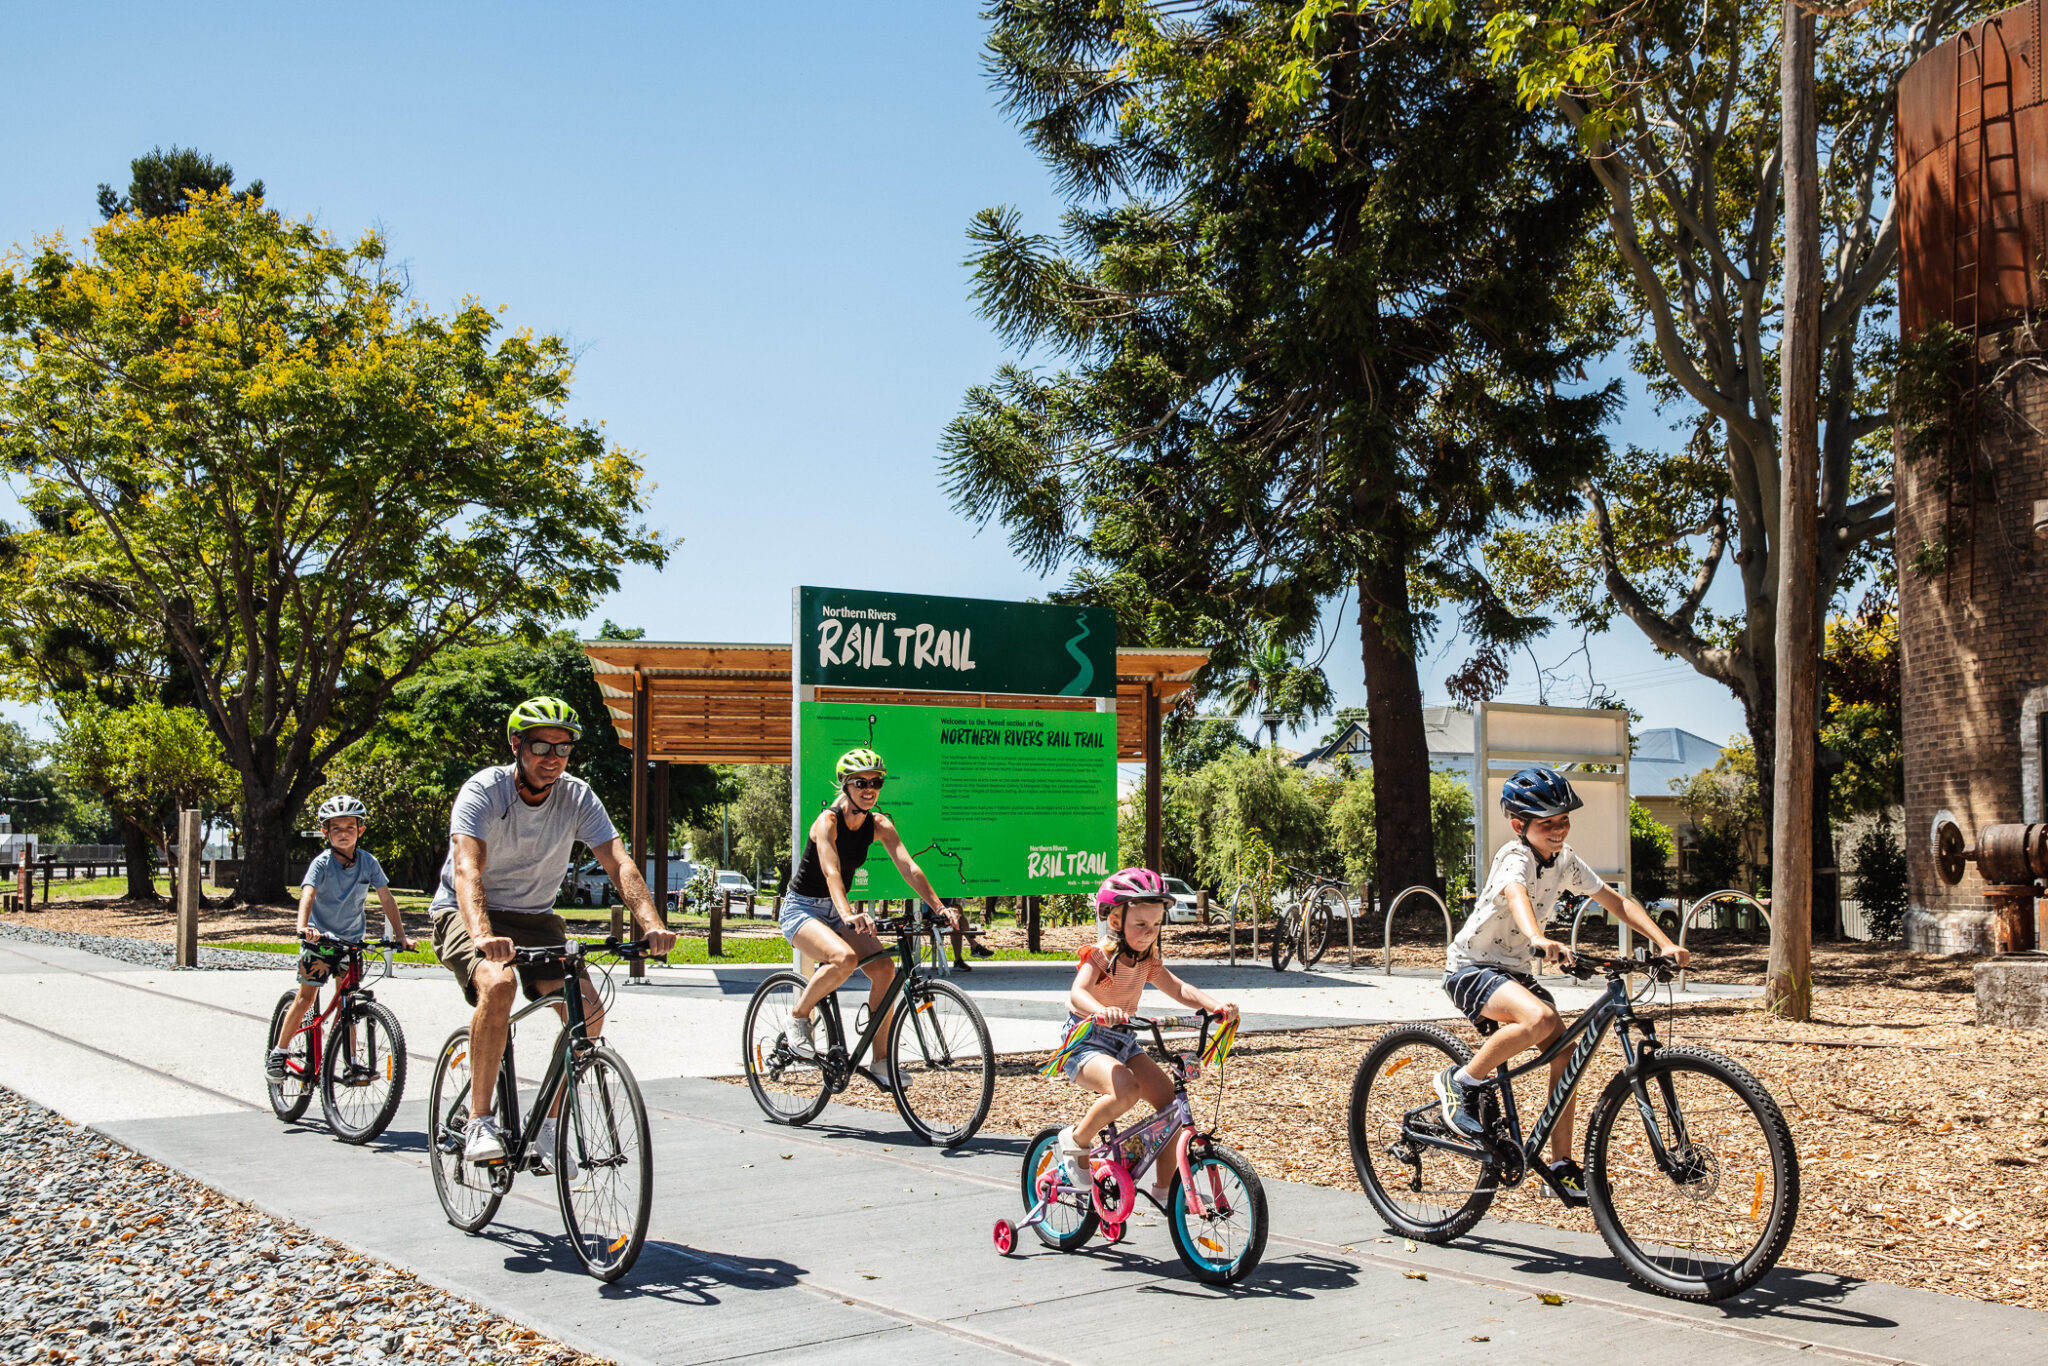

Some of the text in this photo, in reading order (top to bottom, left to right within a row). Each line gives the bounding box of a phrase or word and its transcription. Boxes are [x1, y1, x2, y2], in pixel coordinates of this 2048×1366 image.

[822, 605, 897, 621] Northern Rivers
[817, 618, 976, 672] RAIL TRAIL
[940, 717, 967, 725] Welcome
[976, 718, 986, 726] the
[987, 719, 1005, 727] Tweed
[1006, 719, 1027, 727] section
[1034, 720, 1044, 728] the
[940, 728, 1104, 749] NORTHERN RIVERS RAIL TRAIL
[1027, 850, 1109, 879] RAIL TRAIL
[1528, 1018, 1598, 1152] SPECIALIZED
